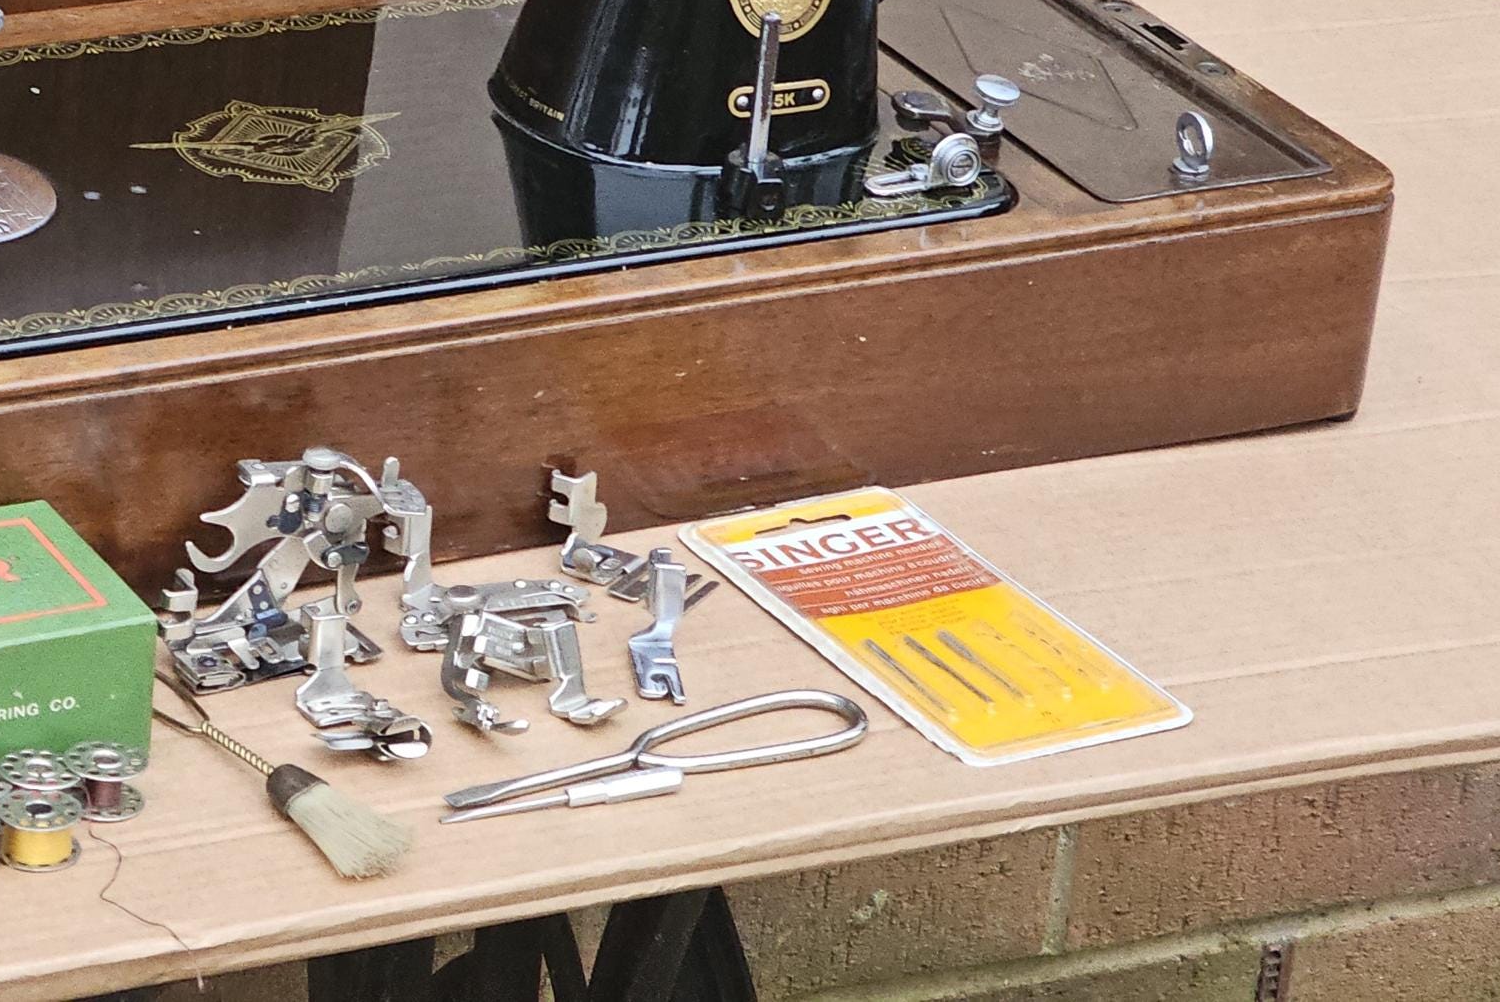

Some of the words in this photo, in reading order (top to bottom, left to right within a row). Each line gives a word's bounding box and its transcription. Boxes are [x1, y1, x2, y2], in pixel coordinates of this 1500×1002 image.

[773, 92, 796, 108] 5K
[726, 517, 936, 570] SINGER
[799, 561, 843, 575] sewing
[843, 549, 895, 567] machine
[895, 539, 942, 556] needles
[775, 579, 822, 593] iguilles
[822, 574, 851, 587] pour
[853, 564, 906, 581] machine
[49, 695, 81, 713] CO.
